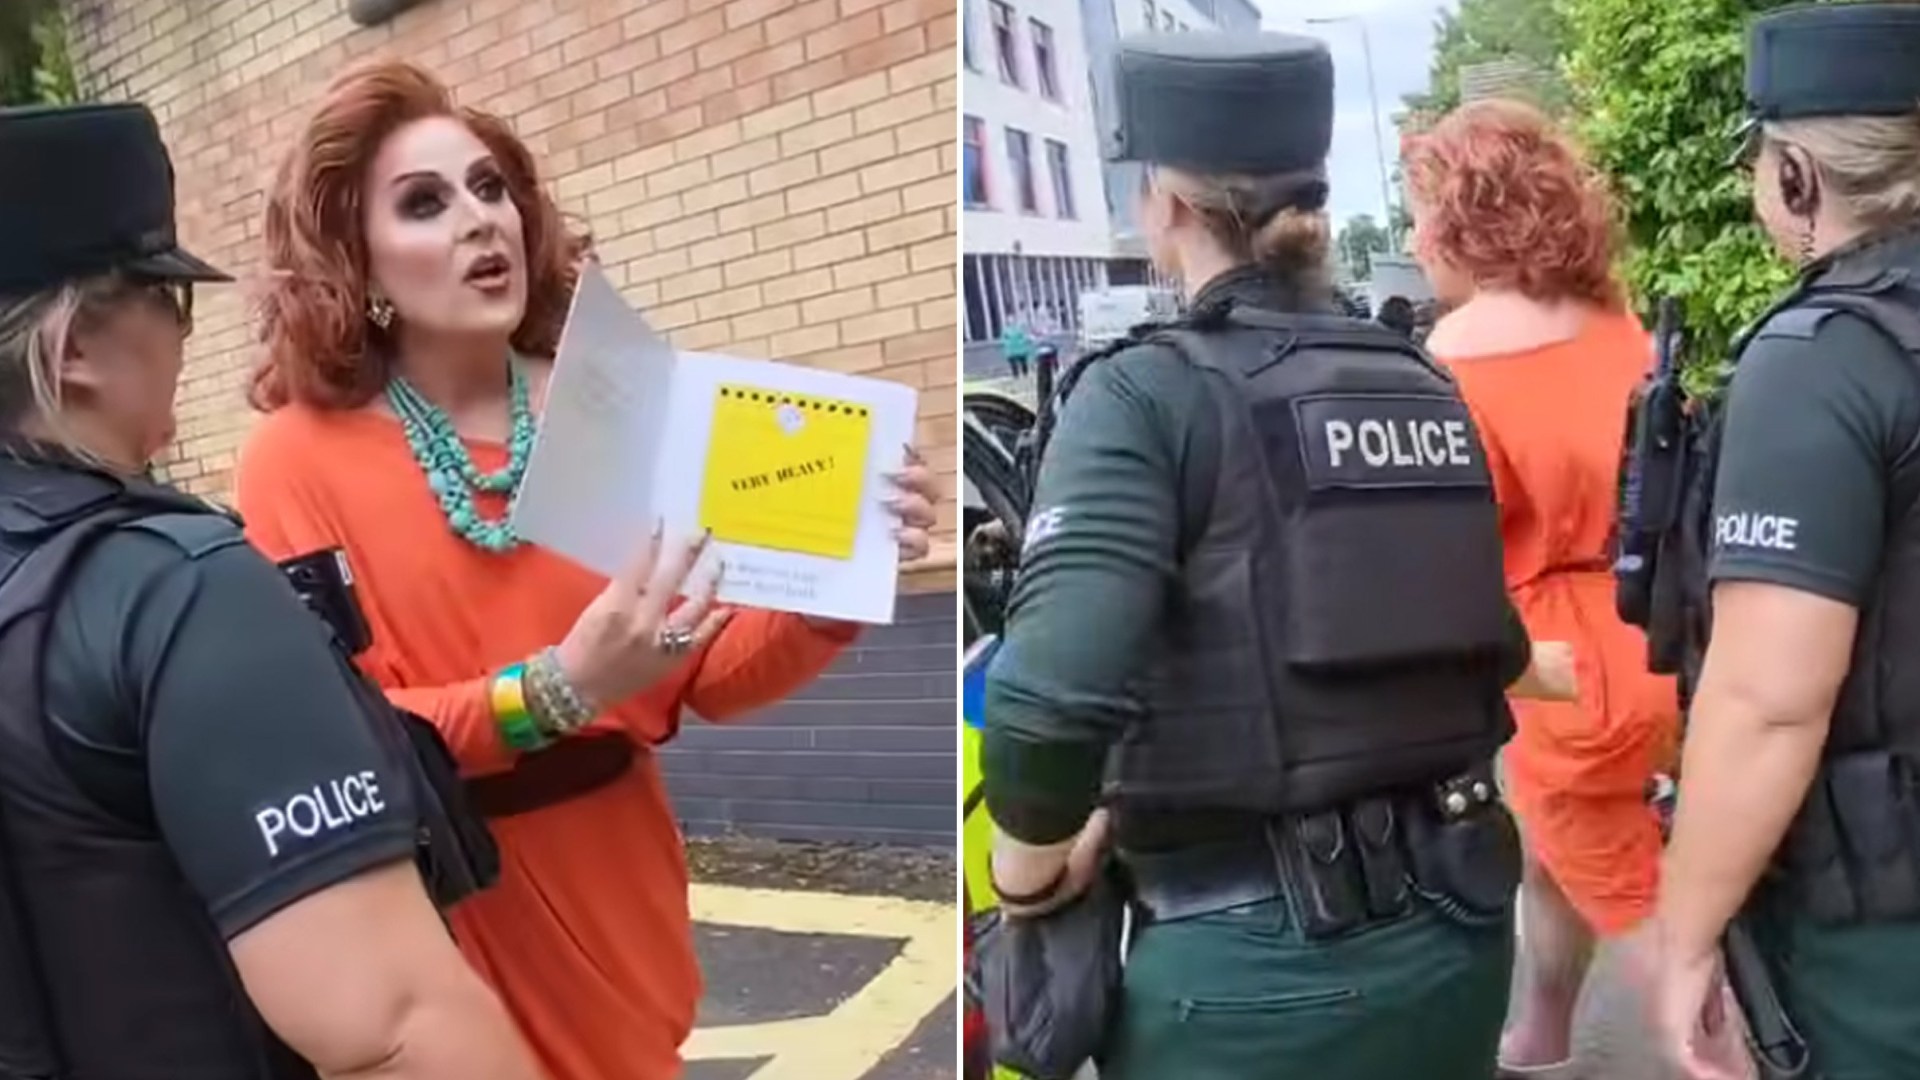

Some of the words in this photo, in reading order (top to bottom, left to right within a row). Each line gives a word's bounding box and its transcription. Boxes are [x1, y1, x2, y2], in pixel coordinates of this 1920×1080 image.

[1325, 418, 1471, 467] POLICE
[1715, 512, 1799, 550] POLICE
[256, 770, 386, 857] POLICE
